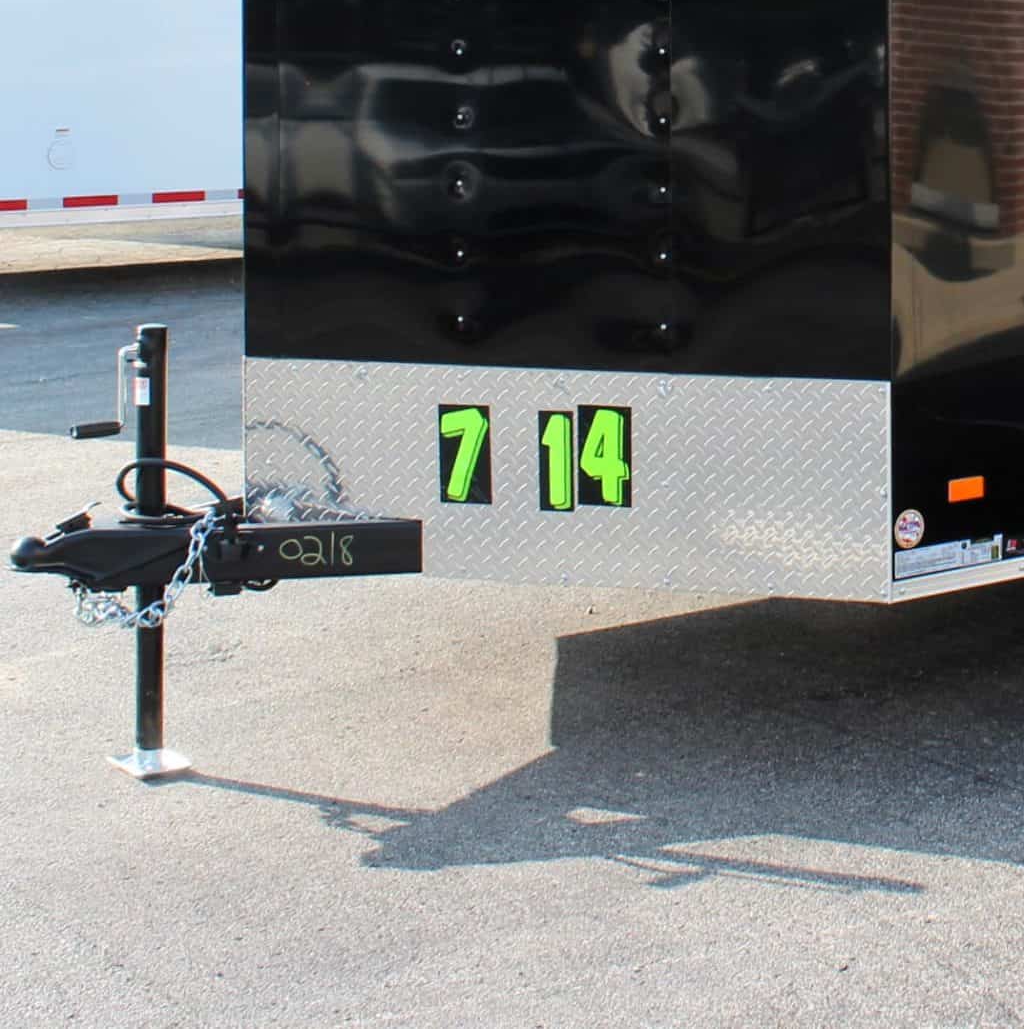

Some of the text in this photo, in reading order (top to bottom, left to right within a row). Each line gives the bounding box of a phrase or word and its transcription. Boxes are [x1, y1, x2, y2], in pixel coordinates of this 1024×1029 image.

[440, 408, 630, 510] 7 14
[278, 530, 355, 567] 0218
